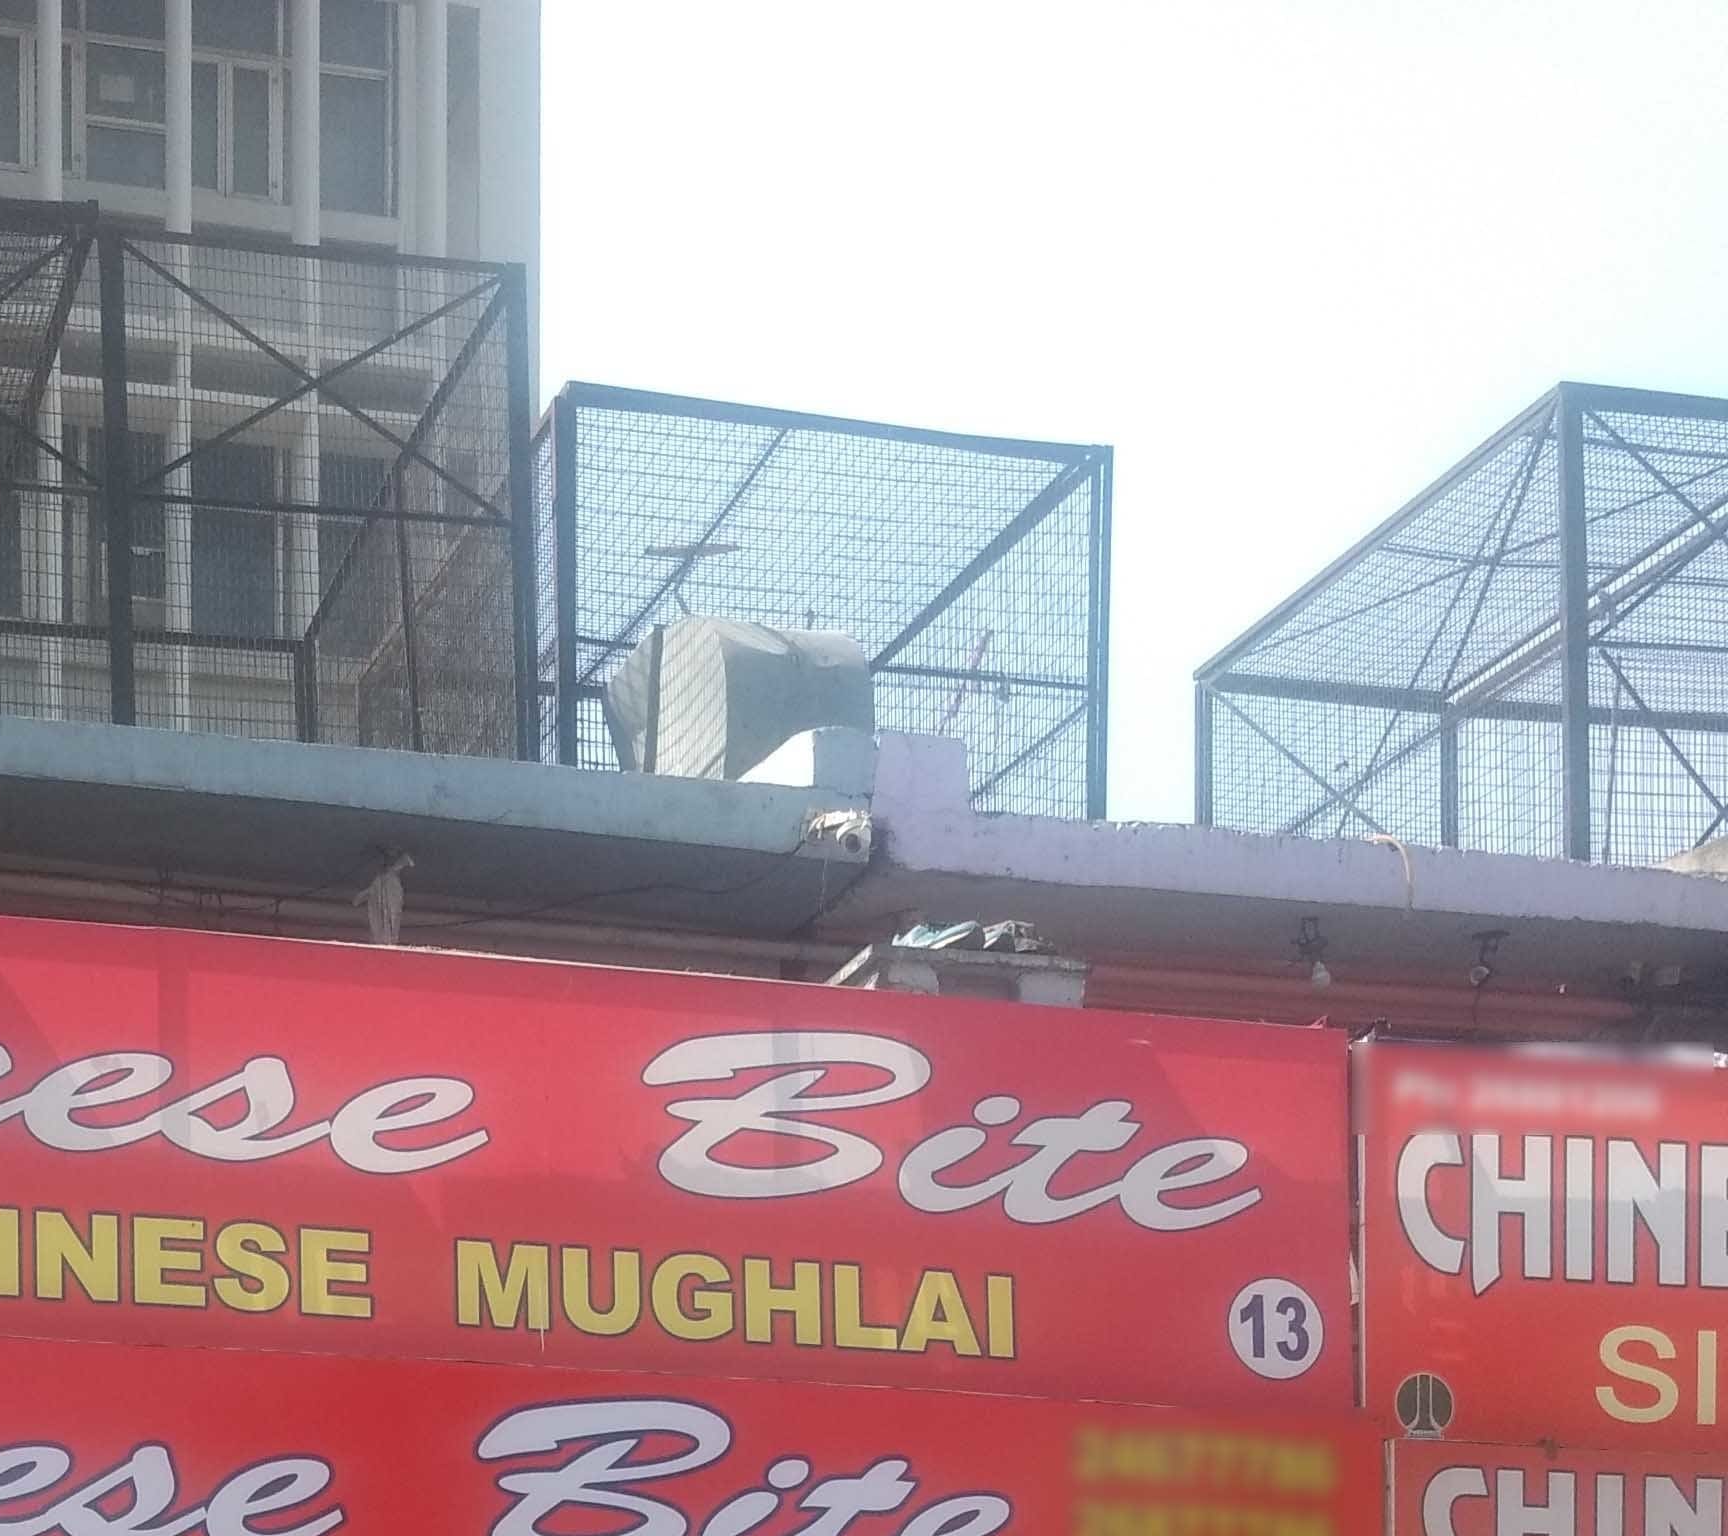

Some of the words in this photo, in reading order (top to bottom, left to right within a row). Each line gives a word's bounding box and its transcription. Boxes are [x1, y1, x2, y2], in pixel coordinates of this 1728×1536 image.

[641, 1030, 1263, 1232] Bite
[455, 1239, 1017, 1361] MUGHLAI
[1238, 1293, 1310, 1363] 13
